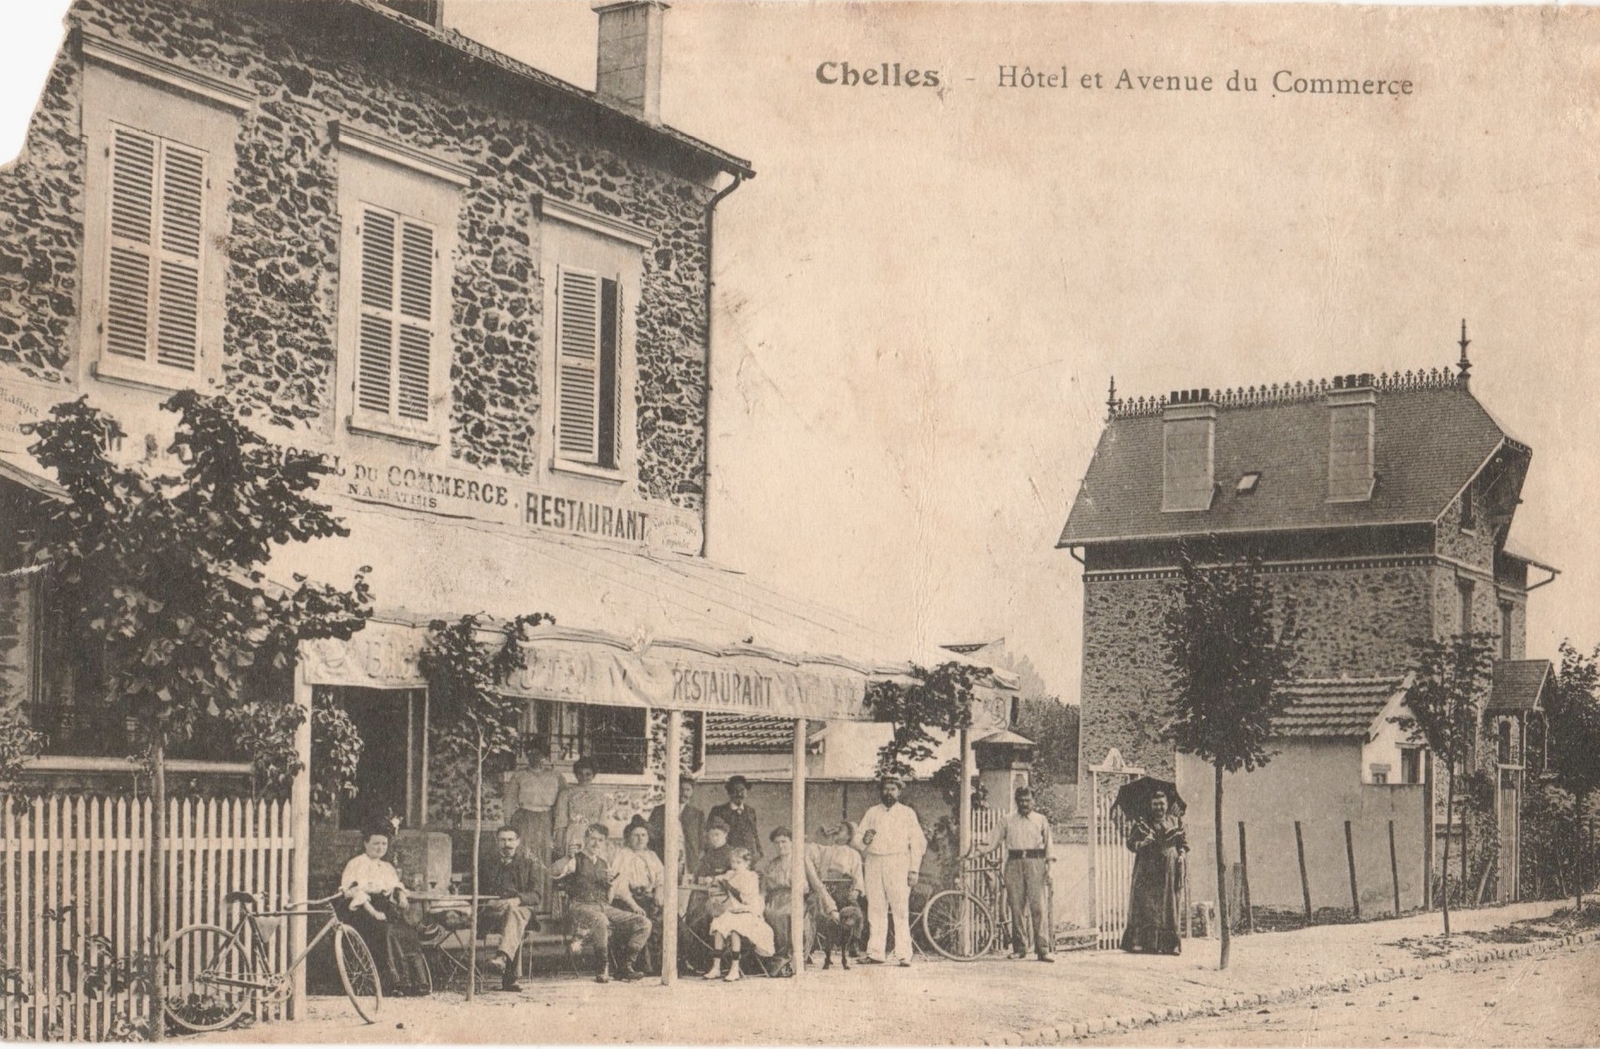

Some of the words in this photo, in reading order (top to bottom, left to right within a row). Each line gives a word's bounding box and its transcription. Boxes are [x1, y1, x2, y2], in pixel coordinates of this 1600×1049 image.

[354, 464, 378, 482] DU
[387, 465, 509, 507] COMMERCE
[525, 491, 649, 541] RESTAURANT
[671, 668, 773, 707] RESTAURANT
